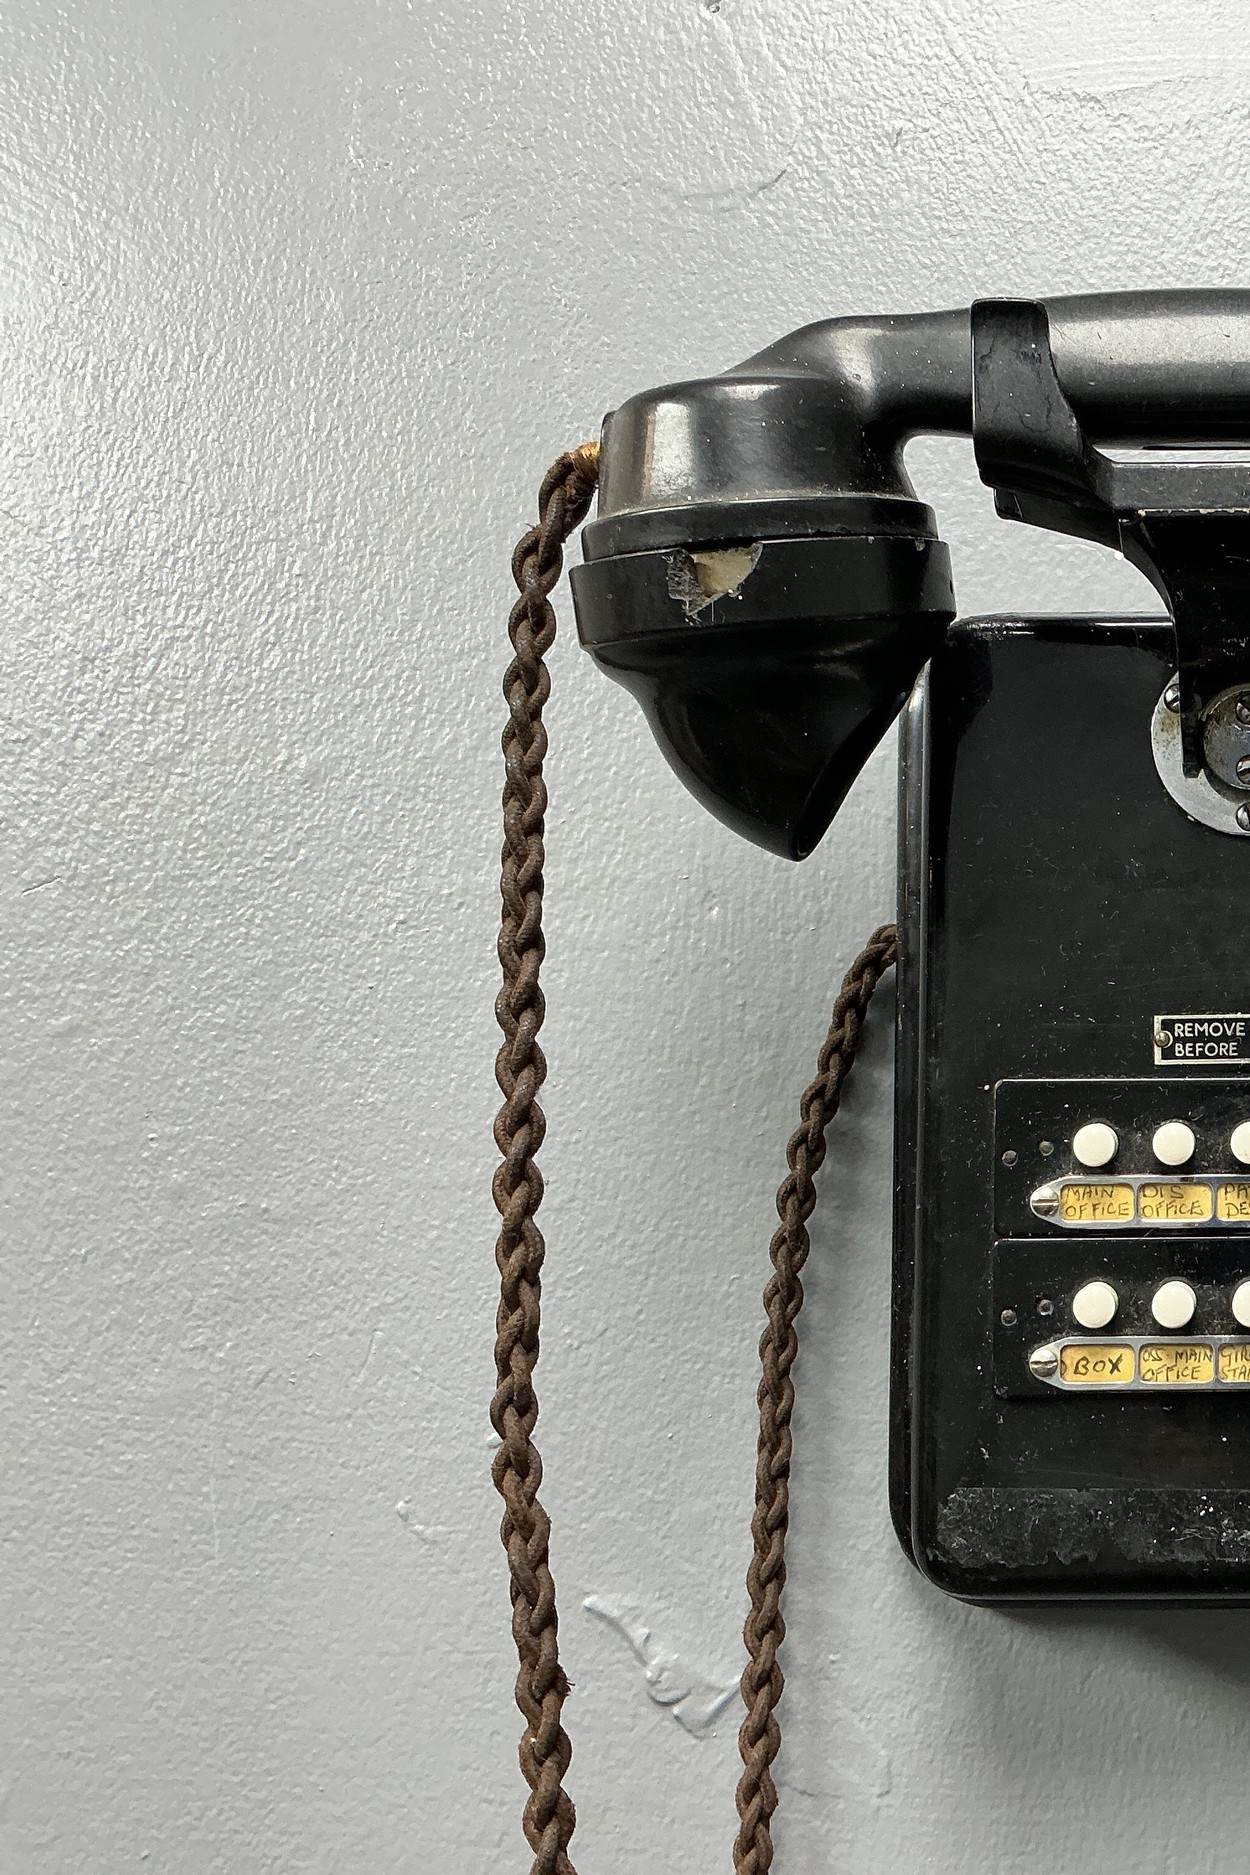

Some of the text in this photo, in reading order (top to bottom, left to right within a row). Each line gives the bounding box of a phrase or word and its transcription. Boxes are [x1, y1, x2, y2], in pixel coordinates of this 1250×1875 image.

[1174, 1022, 1246, 1037] REMOVE
[1175, 1042, 1239, 1057] BEFORE
[1066, 1185, 1114, 1204] MAIN
[1065, 1201, 1130, 1220] OFFICE
[1142, 1200, 1204, 1218] OFFICE
[1074, 1353, 1123, 1375] BOX
[1174, 1349, 1212, 1366] MAIN
[1142, 1363, 1201, 1382] OFFICE
